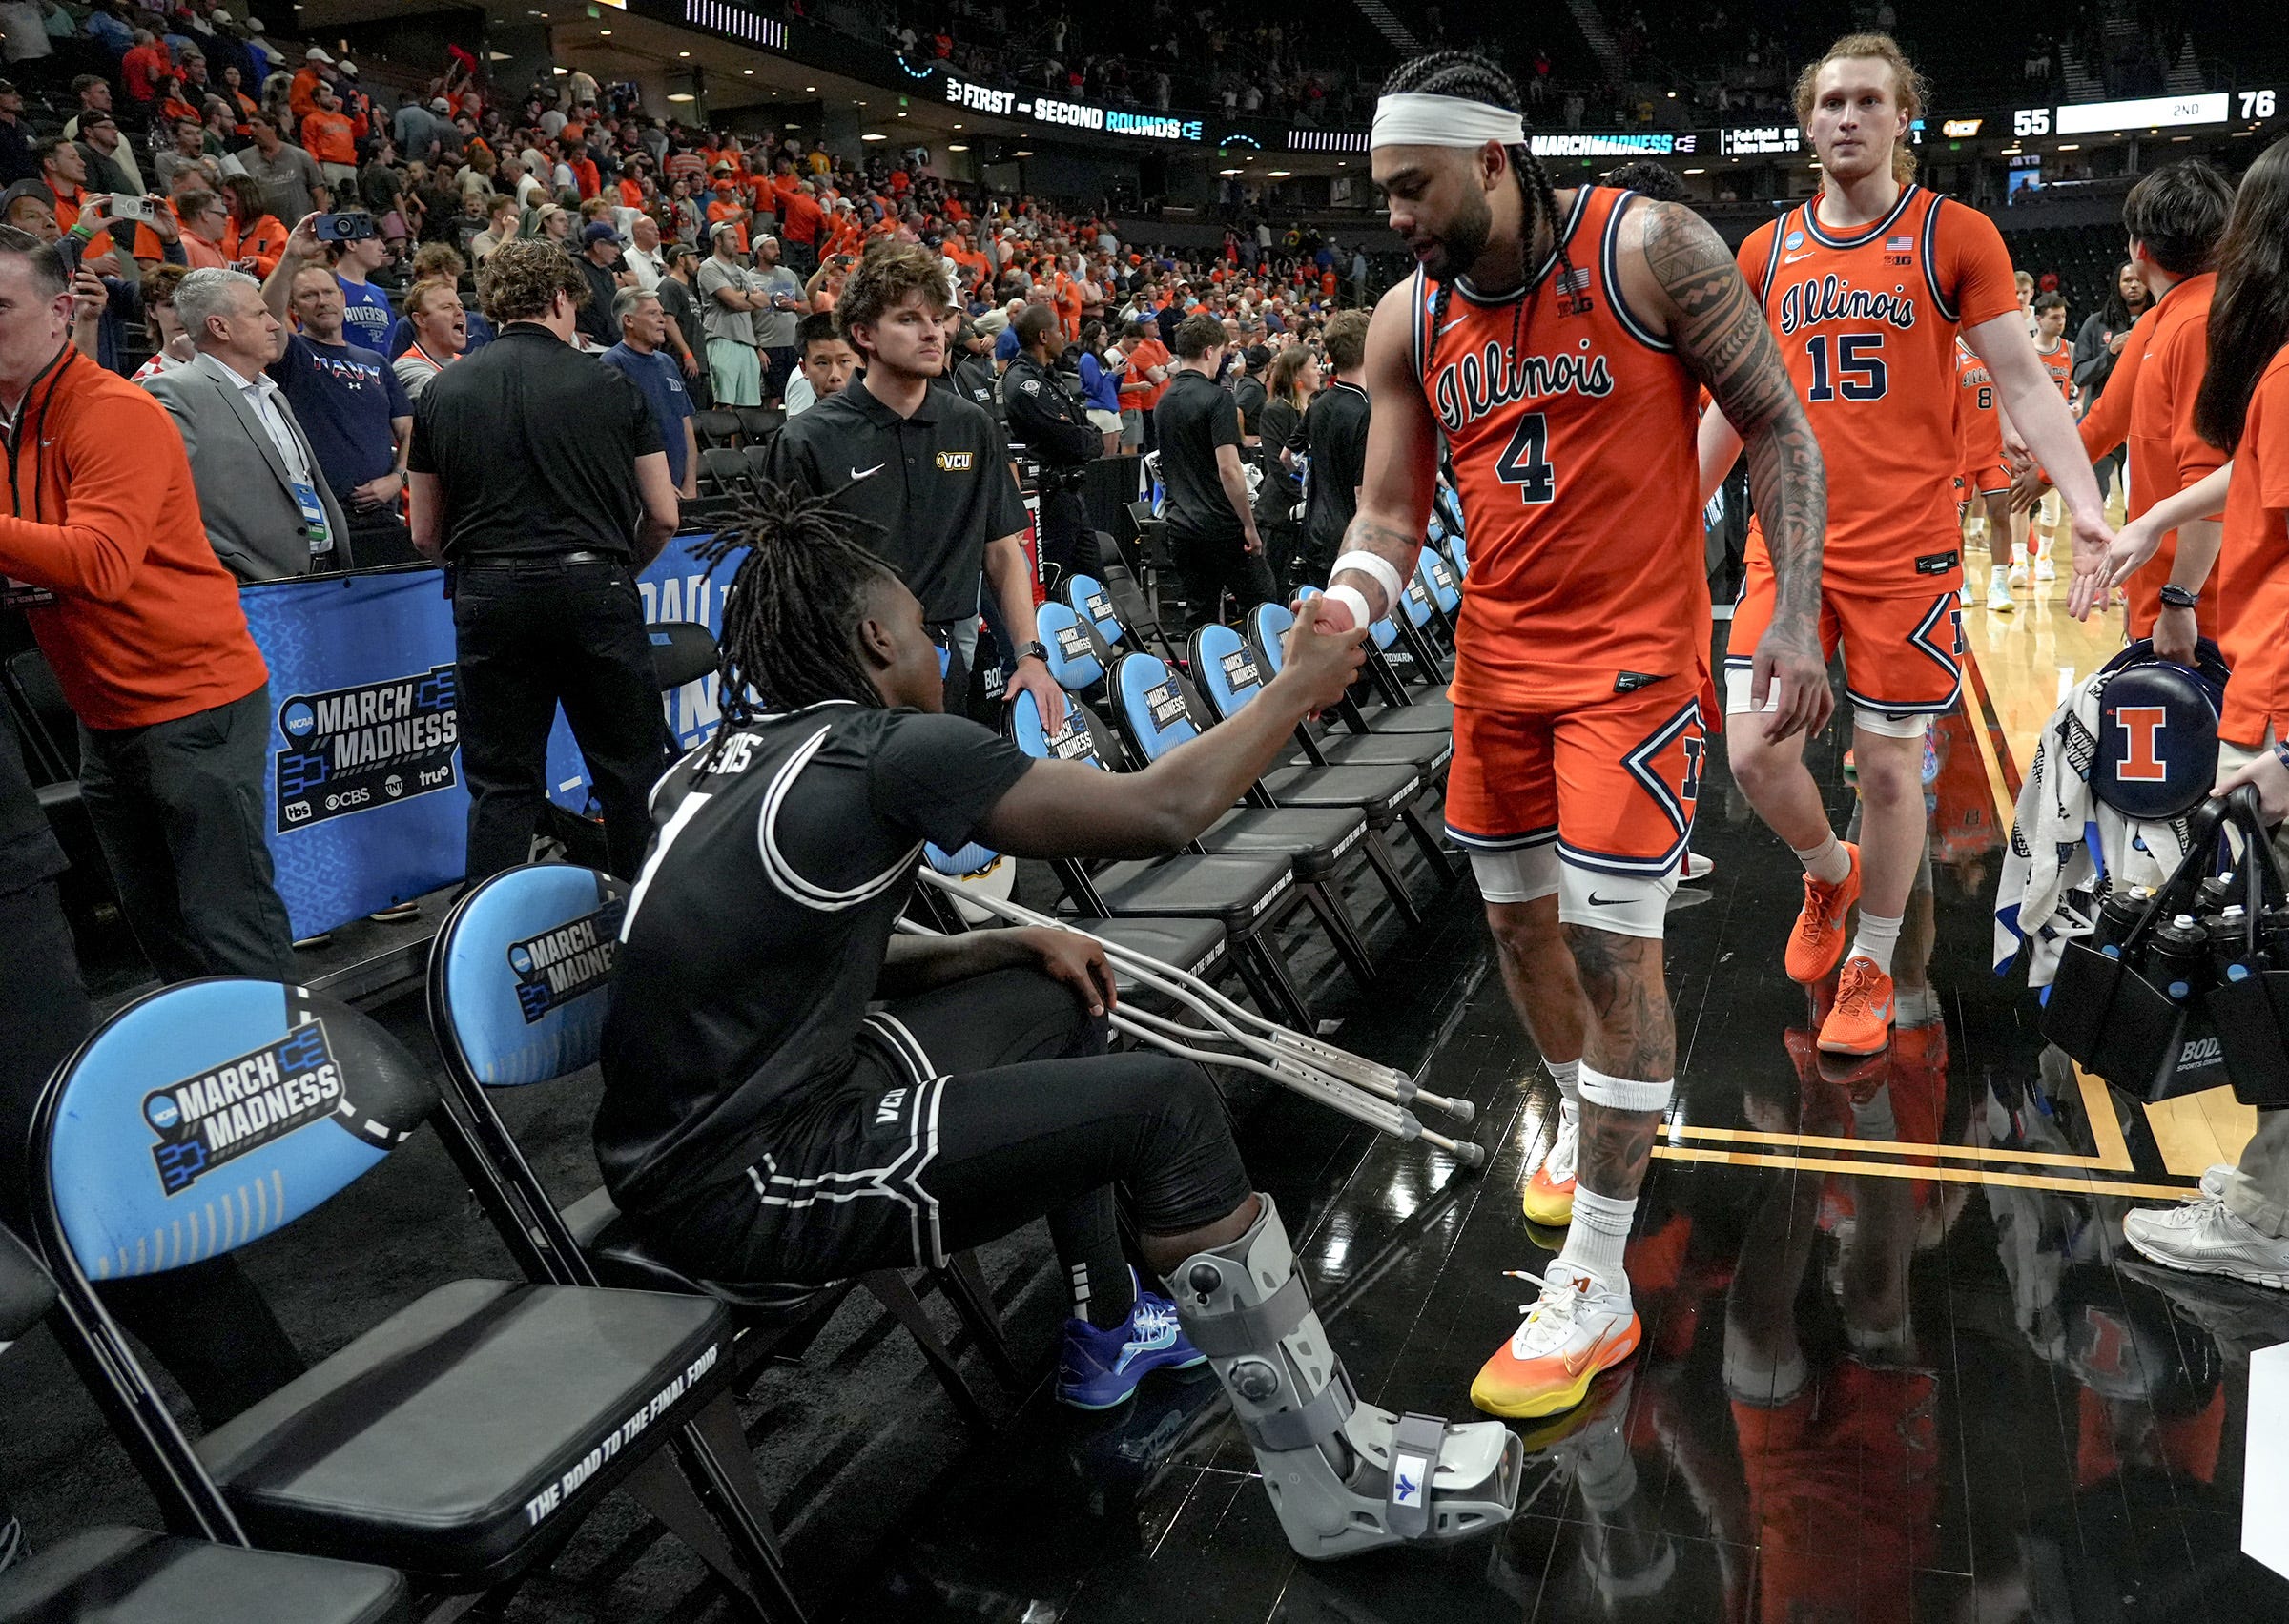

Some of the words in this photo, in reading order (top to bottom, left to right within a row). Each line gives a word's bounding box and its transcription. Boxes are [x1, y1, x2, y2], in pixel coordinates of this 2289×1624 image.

[963, 83, 1015, 114] FIRST
[1034, 98, 1103, 130] SECOND
[1106, 111, 1181, 139] ROUNDS
[2014, 108, 2050, 136] 55
[2173, 103, 2199, 116] 2ND
[2238, 91, 2276, 120] 76
[1780, 273, 1915, 336] Illinois
[312, 353, 381, 385] NAVY
[1436, 338, 1614, 432] Illinois
[1805, 334, 1887, 402] 15
[1977, 387, 1993, 410] 8
[940, 452, 972, 470] VCU
[1495, 412, 1556, 504] 4
[1034, 505, 1045, 584] BODYARMO
[317, 684, 413, 736] MARCH
[1148, 685, 1170, 709] MARCH
[1156, 696, 1186, 722] MADNESS
[289, 716, 314, 730] NCAA
[335, 709, 458, 771] MADNESS
[2116, 706, 2166, 782] I
[1056, 730, 1093, 760] MADNESS
[384, 780, 403, 792] TNT
[1681, 735, 1701, 800] I
[287, 804, 310, 820] tbs
[340, 787, 371, 807] CBS
[528, 920, 597, 971] MARCH
[547, 939, 616, 994] MADNE
[175, 1051, 280, 1123] MARCH
[2176, 1060, 2202, 1072] SPORTS
[203, 1064, 339, 1152] MADNESS
[876, 1088, 908, 1124] VCU
[526, 1482, 560, 1526] THE
[562, 1448, 602, 1499] ROAD
[602, 1430, 621, 1464] TO
[622, 1406, 649, 1445] THE
[650, 1375, 686, 1422] FINAL
[687, 1346, 718, 1389] FOUR
